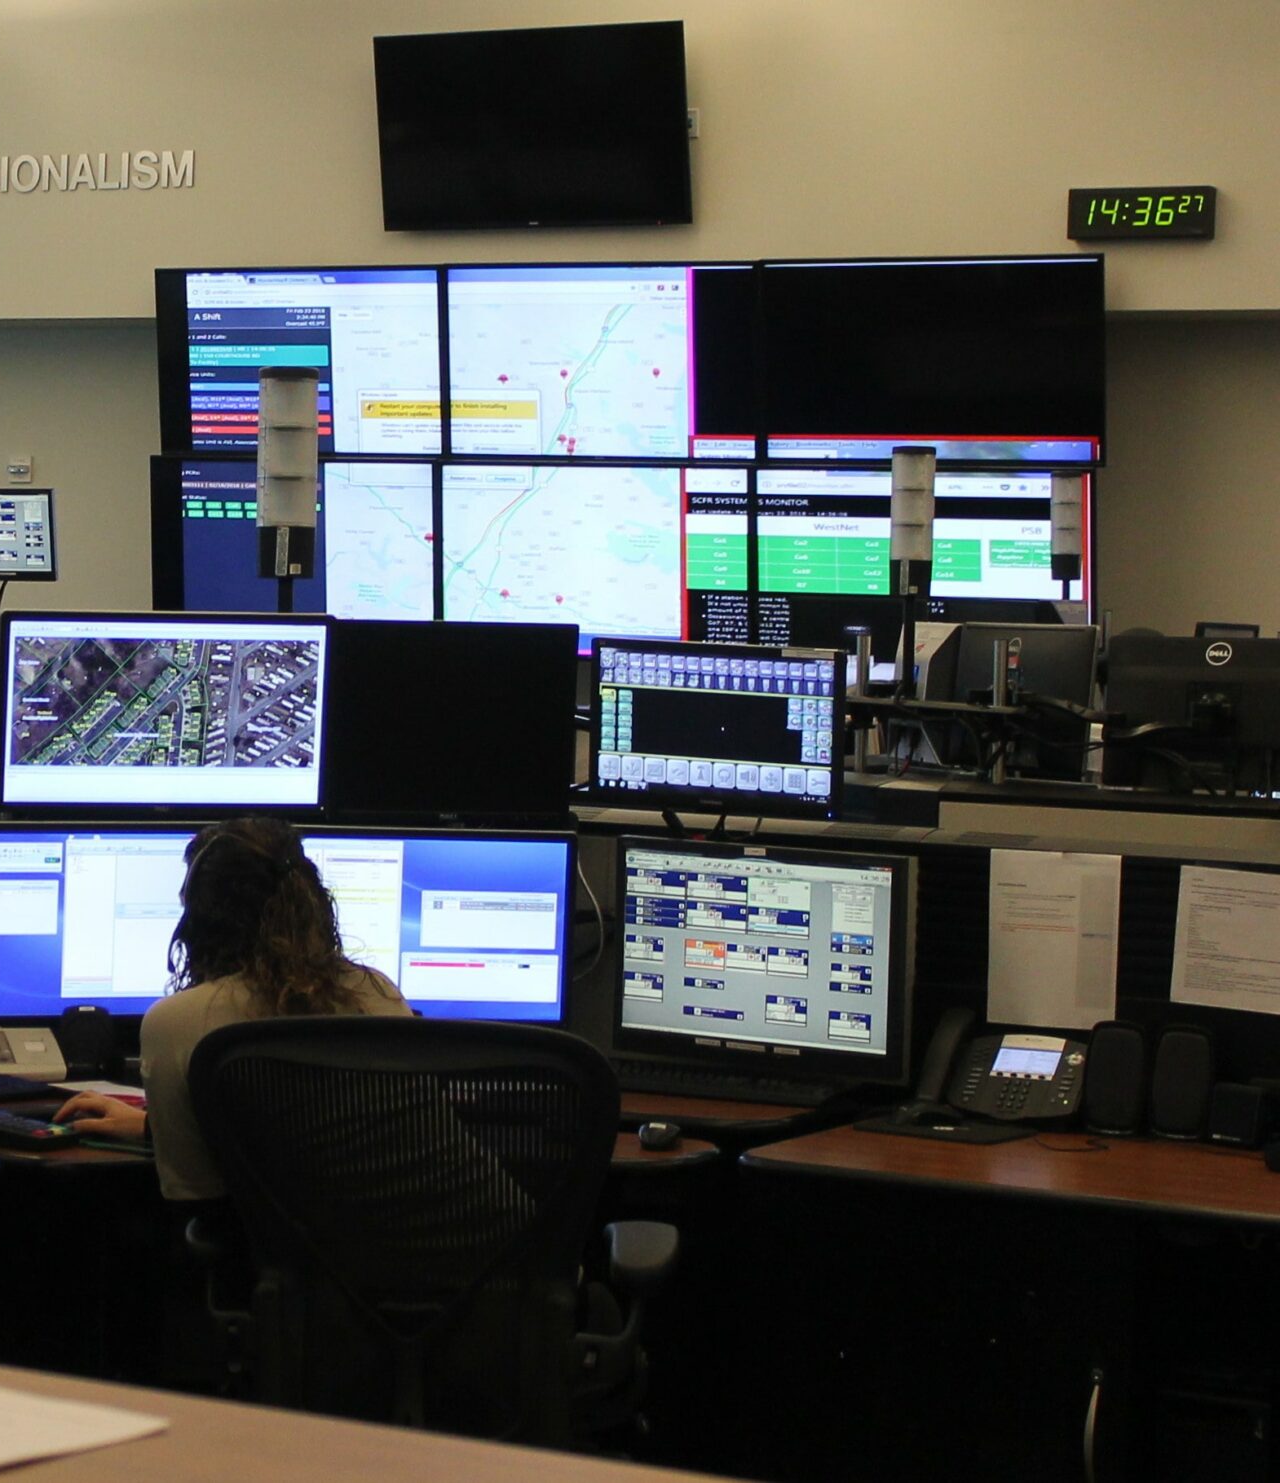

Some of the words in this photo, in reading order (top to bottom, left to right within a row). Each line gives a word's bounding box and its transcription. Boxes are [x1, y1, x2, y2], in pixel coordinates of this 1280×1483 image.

[1088, 196, 1175, 226] 14:36
[1178, 195, 1204, 213] 27
[202, 313, 221, 321] Shift
[814, 523, 859, 531] WestNet
